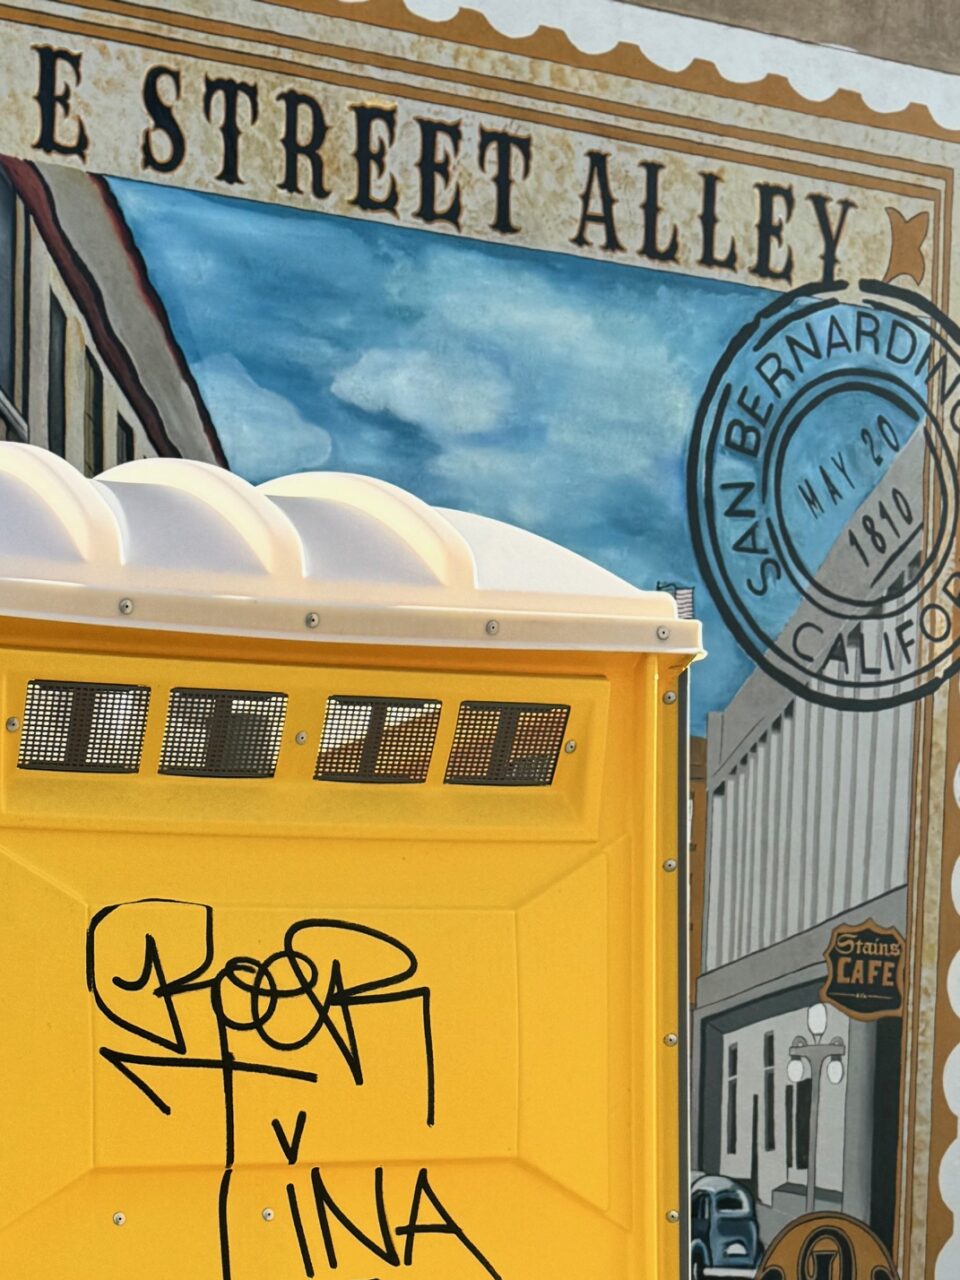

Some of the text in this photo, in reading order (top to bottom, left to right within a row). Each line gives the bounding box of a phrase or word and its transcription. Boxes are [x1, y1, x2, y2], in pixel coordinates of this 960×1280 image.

[31, 43, 858, 285] E STREET ALLEY
[720, 310, 960, 596] SAN BERNARDIN
[797, 415, 900, 519] MAY 20
[847, 487, 913, 568] 1810
[835, 933, 900, 957] Stains
[836, 957, 895, 987] CAFE
